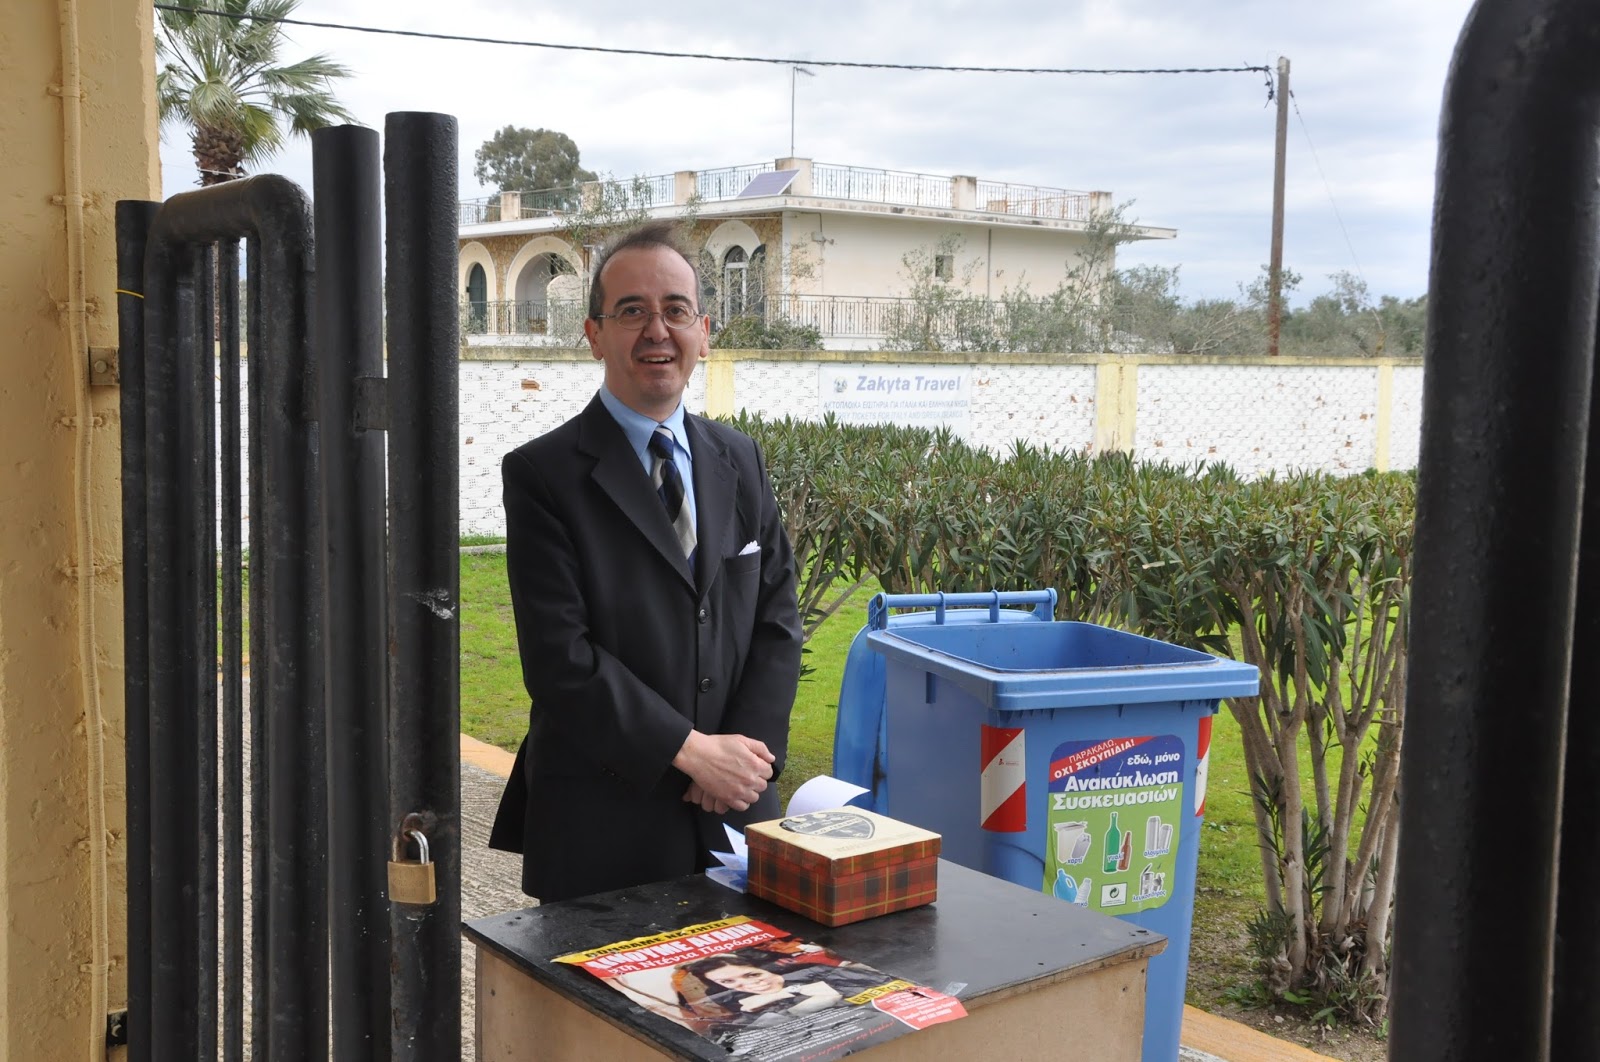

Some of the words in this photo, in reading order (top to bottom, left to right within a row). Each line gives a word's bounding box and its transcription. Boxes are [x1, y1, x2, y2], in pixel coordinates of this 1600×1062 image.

[856, 375, 910, 394] Zakyta
[915, 375, 961, 391] Travel
[878, 411, 889, 420] FOR
[1054, 766, 1074, 779] ΟΧΙ
[1076, 738, 1136, 771] ΣΚΟΥΠΙΔΙΑ!
[1127, 753, 1152, 766] εδώ,
[1155, 752, 1180, 765] μόνο
[1064, 770, 1178, 792] Ανακύκλωση
[1053, 785, 1178, 811] Συσκευασιών
[686, 924, 763, 947] ΑΓΑΠΗ
[639, 951, 699, 968] Ντένια
[698, 932, 775, 955] Παράσχη
